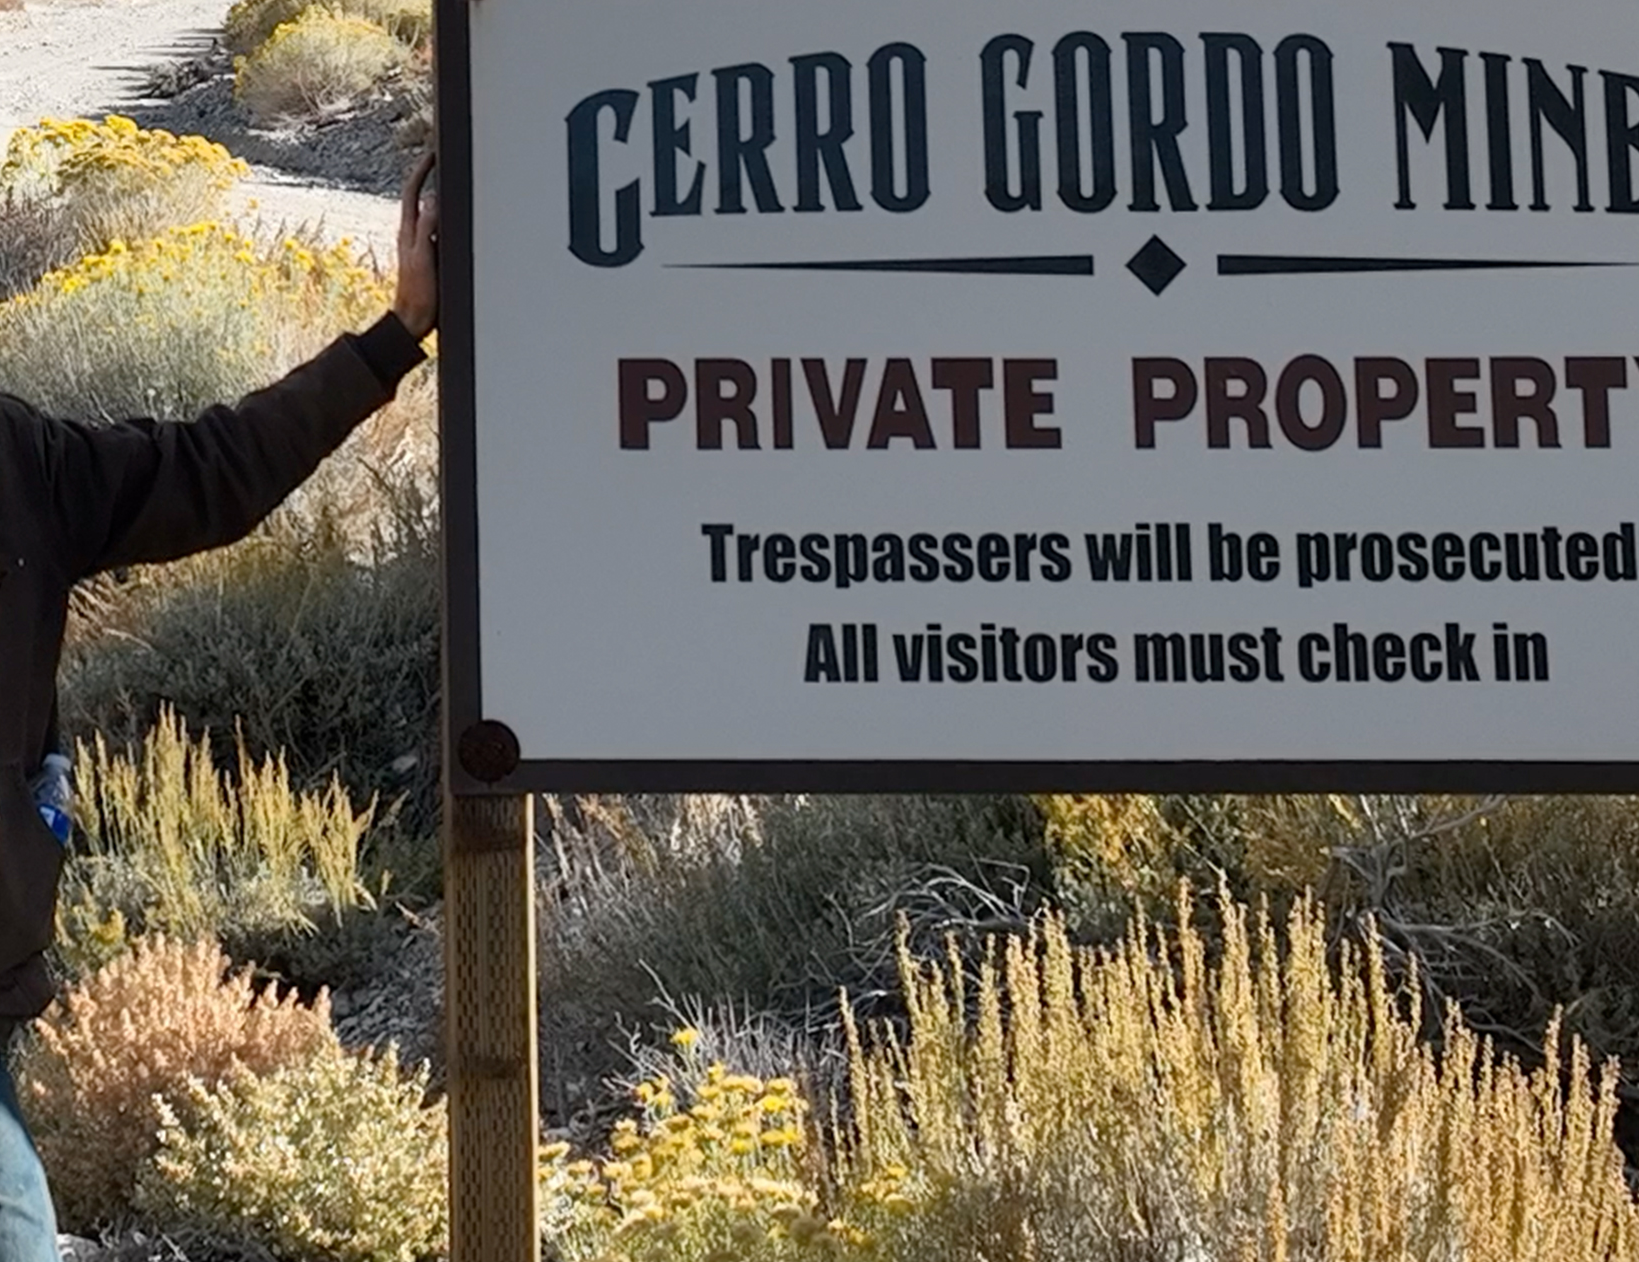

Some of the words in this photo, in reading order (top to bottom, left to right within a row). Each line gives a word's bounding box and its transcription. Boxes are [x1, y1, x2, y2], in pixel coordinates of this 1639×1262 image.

[564, 41, 932, 269] CERRO
[978, 30, 1341, 214] GORDO
[617, 356, 1063, 451] PRIVATE
[701, 523, 1072, 589] Trespassers
[1084, 522, 1193, 582] will
[1207, 522, 1281, 583] be
[1295, 521, 1638, 589] prosecuted
[803, 623, 879, 683] All
[892, 622, 1119, 684] visitors
[1133, 626, 1285, 684] must
[1297, 622, 1481, 683] check
[1492, 622, 1550, 682] in
